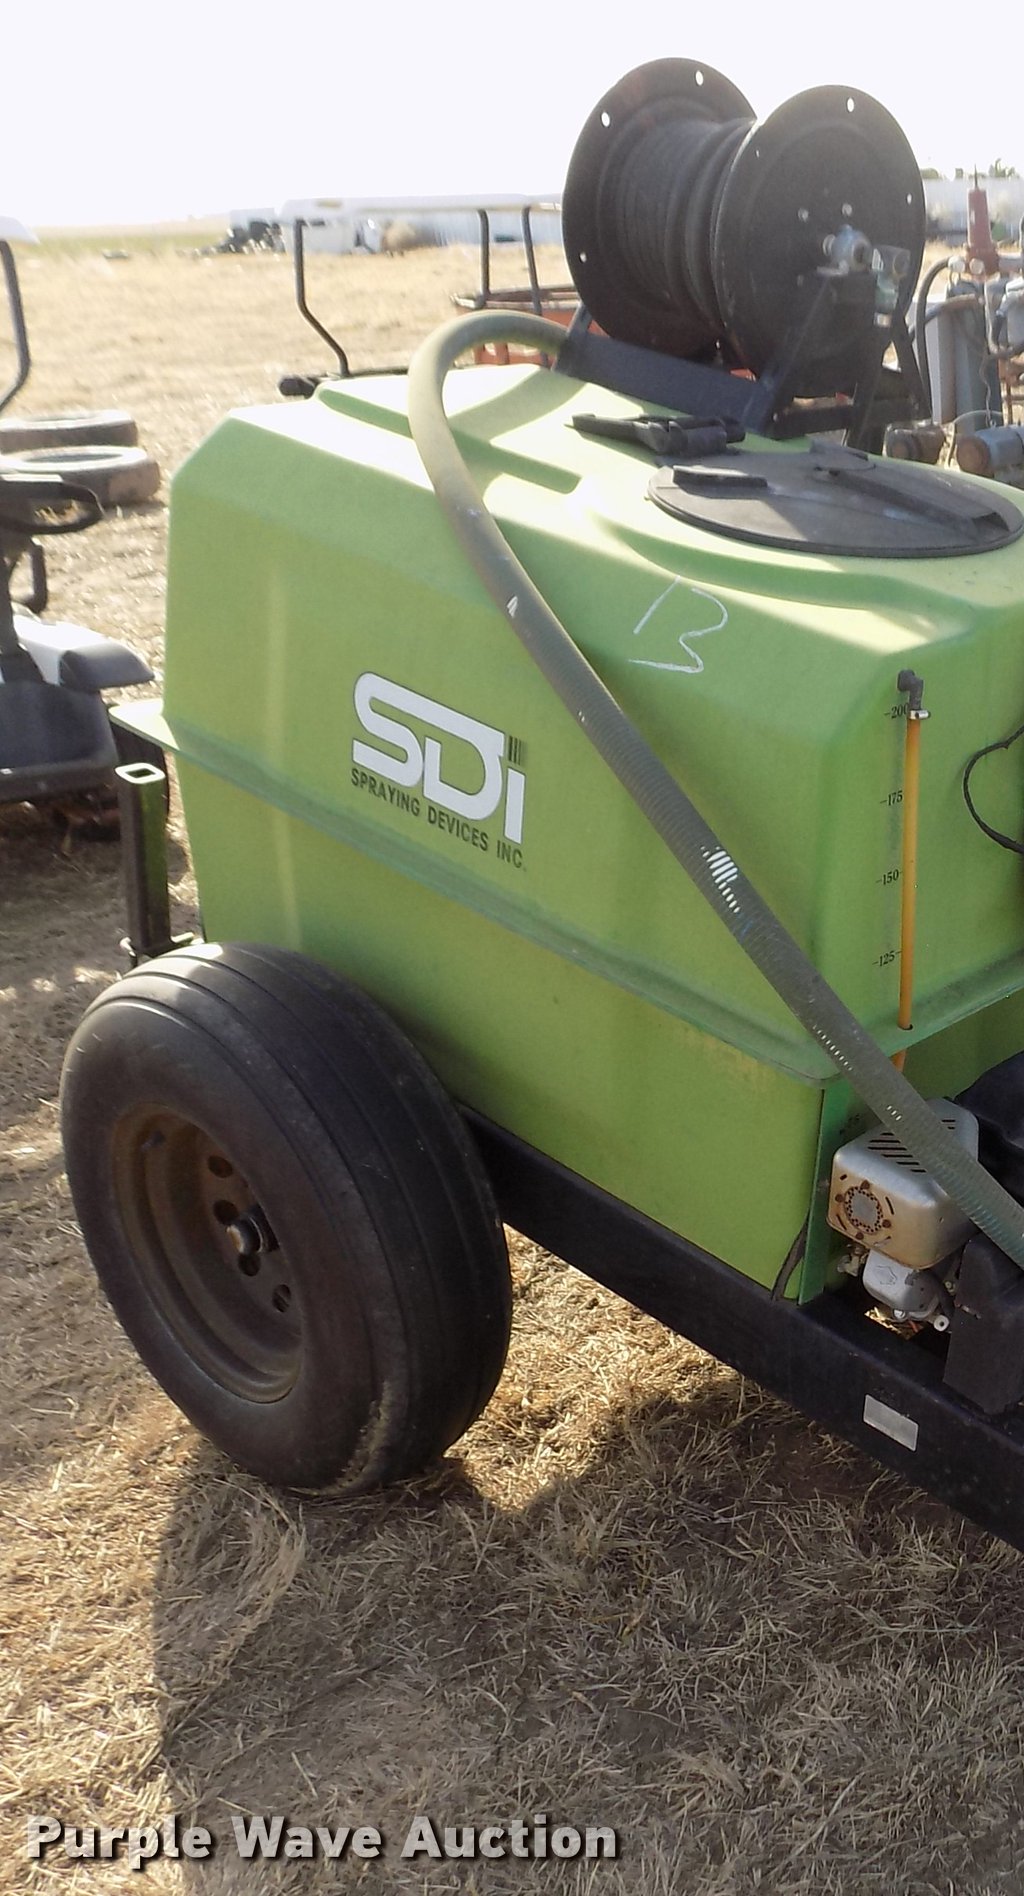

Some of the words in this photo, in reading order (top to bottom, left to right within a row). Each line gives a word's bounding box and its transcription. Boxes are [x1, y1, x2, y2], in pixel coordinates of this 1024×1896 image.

[888, 790, 903, 806] 175
[351, 768, 420, 817] SPRAYING
[427, 805, 489, 852] DEVICES
[497, 840, 527, 872] INC.
[882, 869, 899, 885] 150
[879, 950, 896, 967] 125
